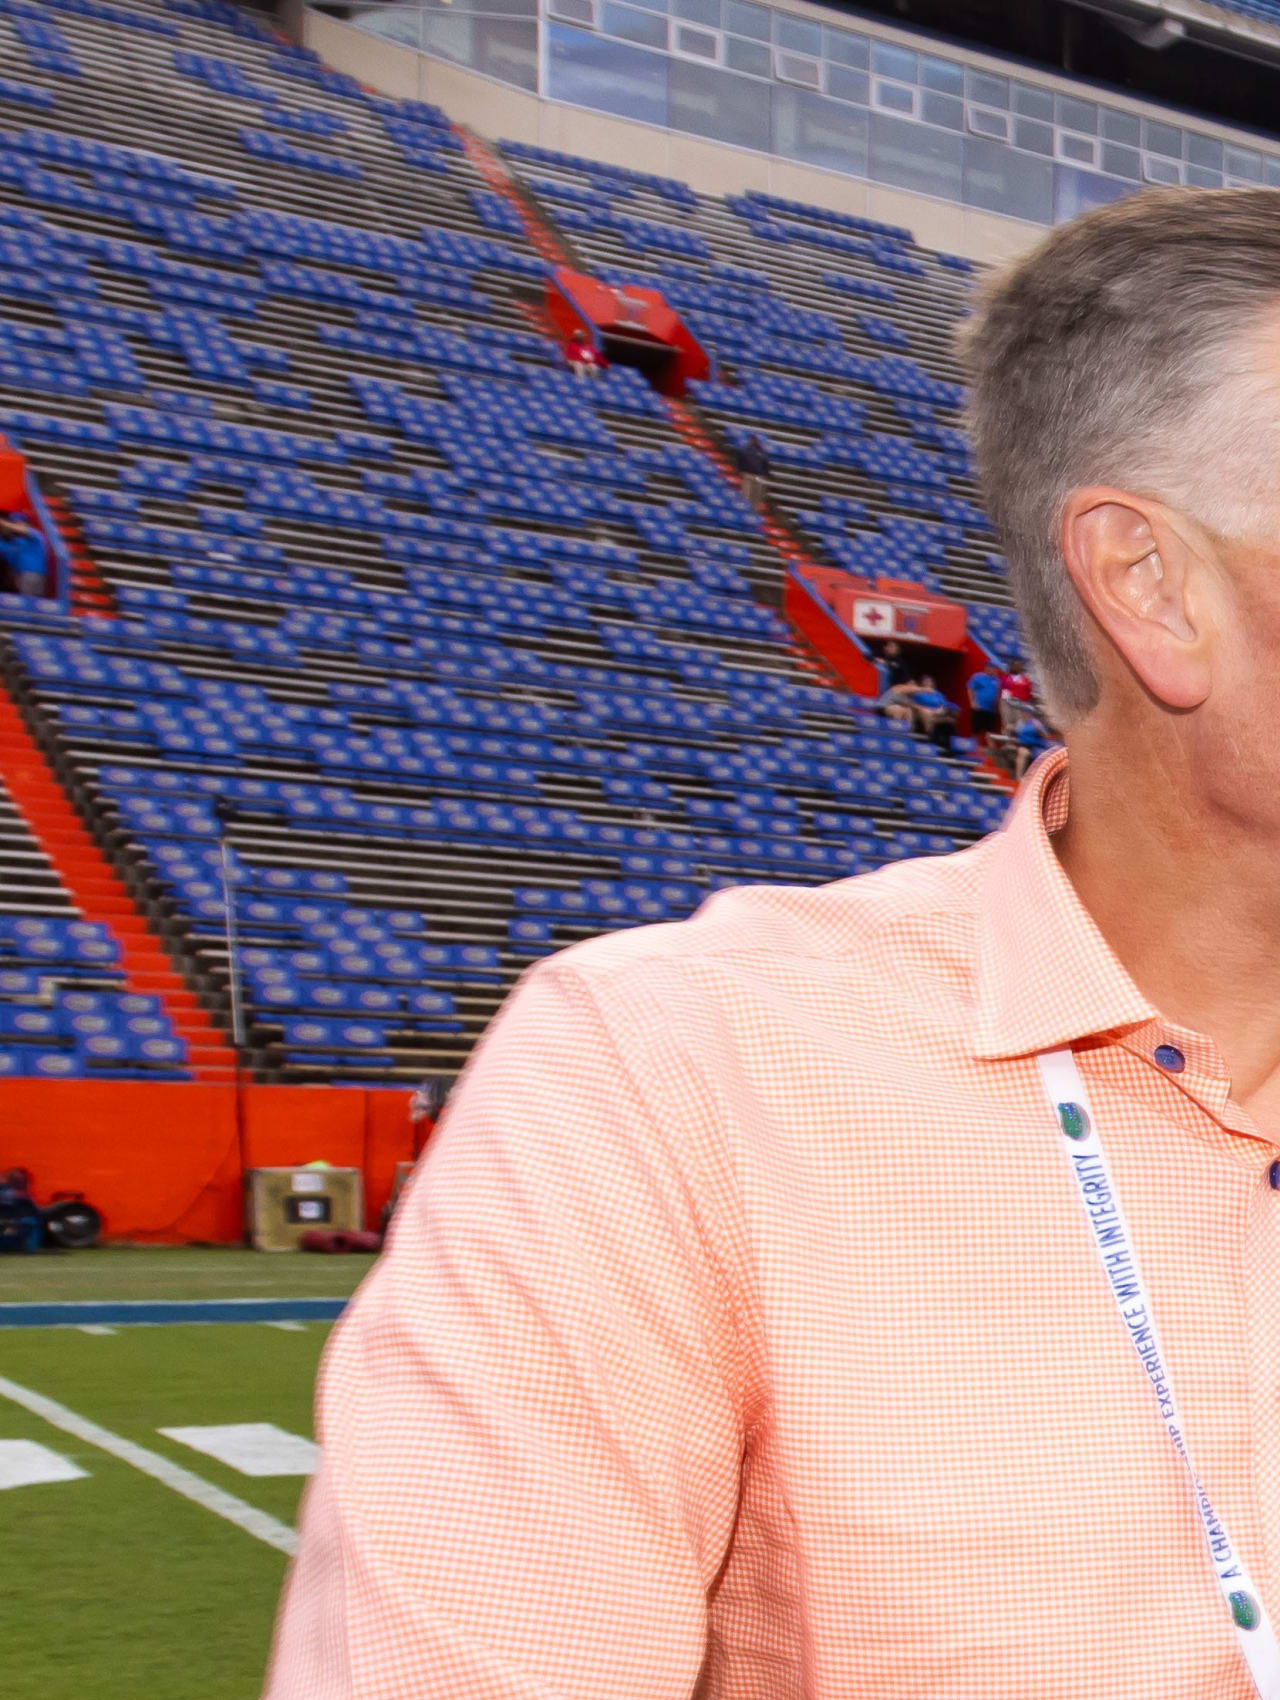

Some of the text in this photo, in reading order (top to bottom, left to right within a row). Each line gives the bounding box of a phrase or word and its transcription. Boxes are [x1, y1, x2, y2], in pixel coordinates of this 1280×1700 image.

[1072, 1154, 1126, 1248] INTEGRITY
[1104, 1250, 1141, 1304] WITH
[1123, 1304, 1175, 1419] EXPERIENCE
[1220, 1564, 1242, 1580] A
